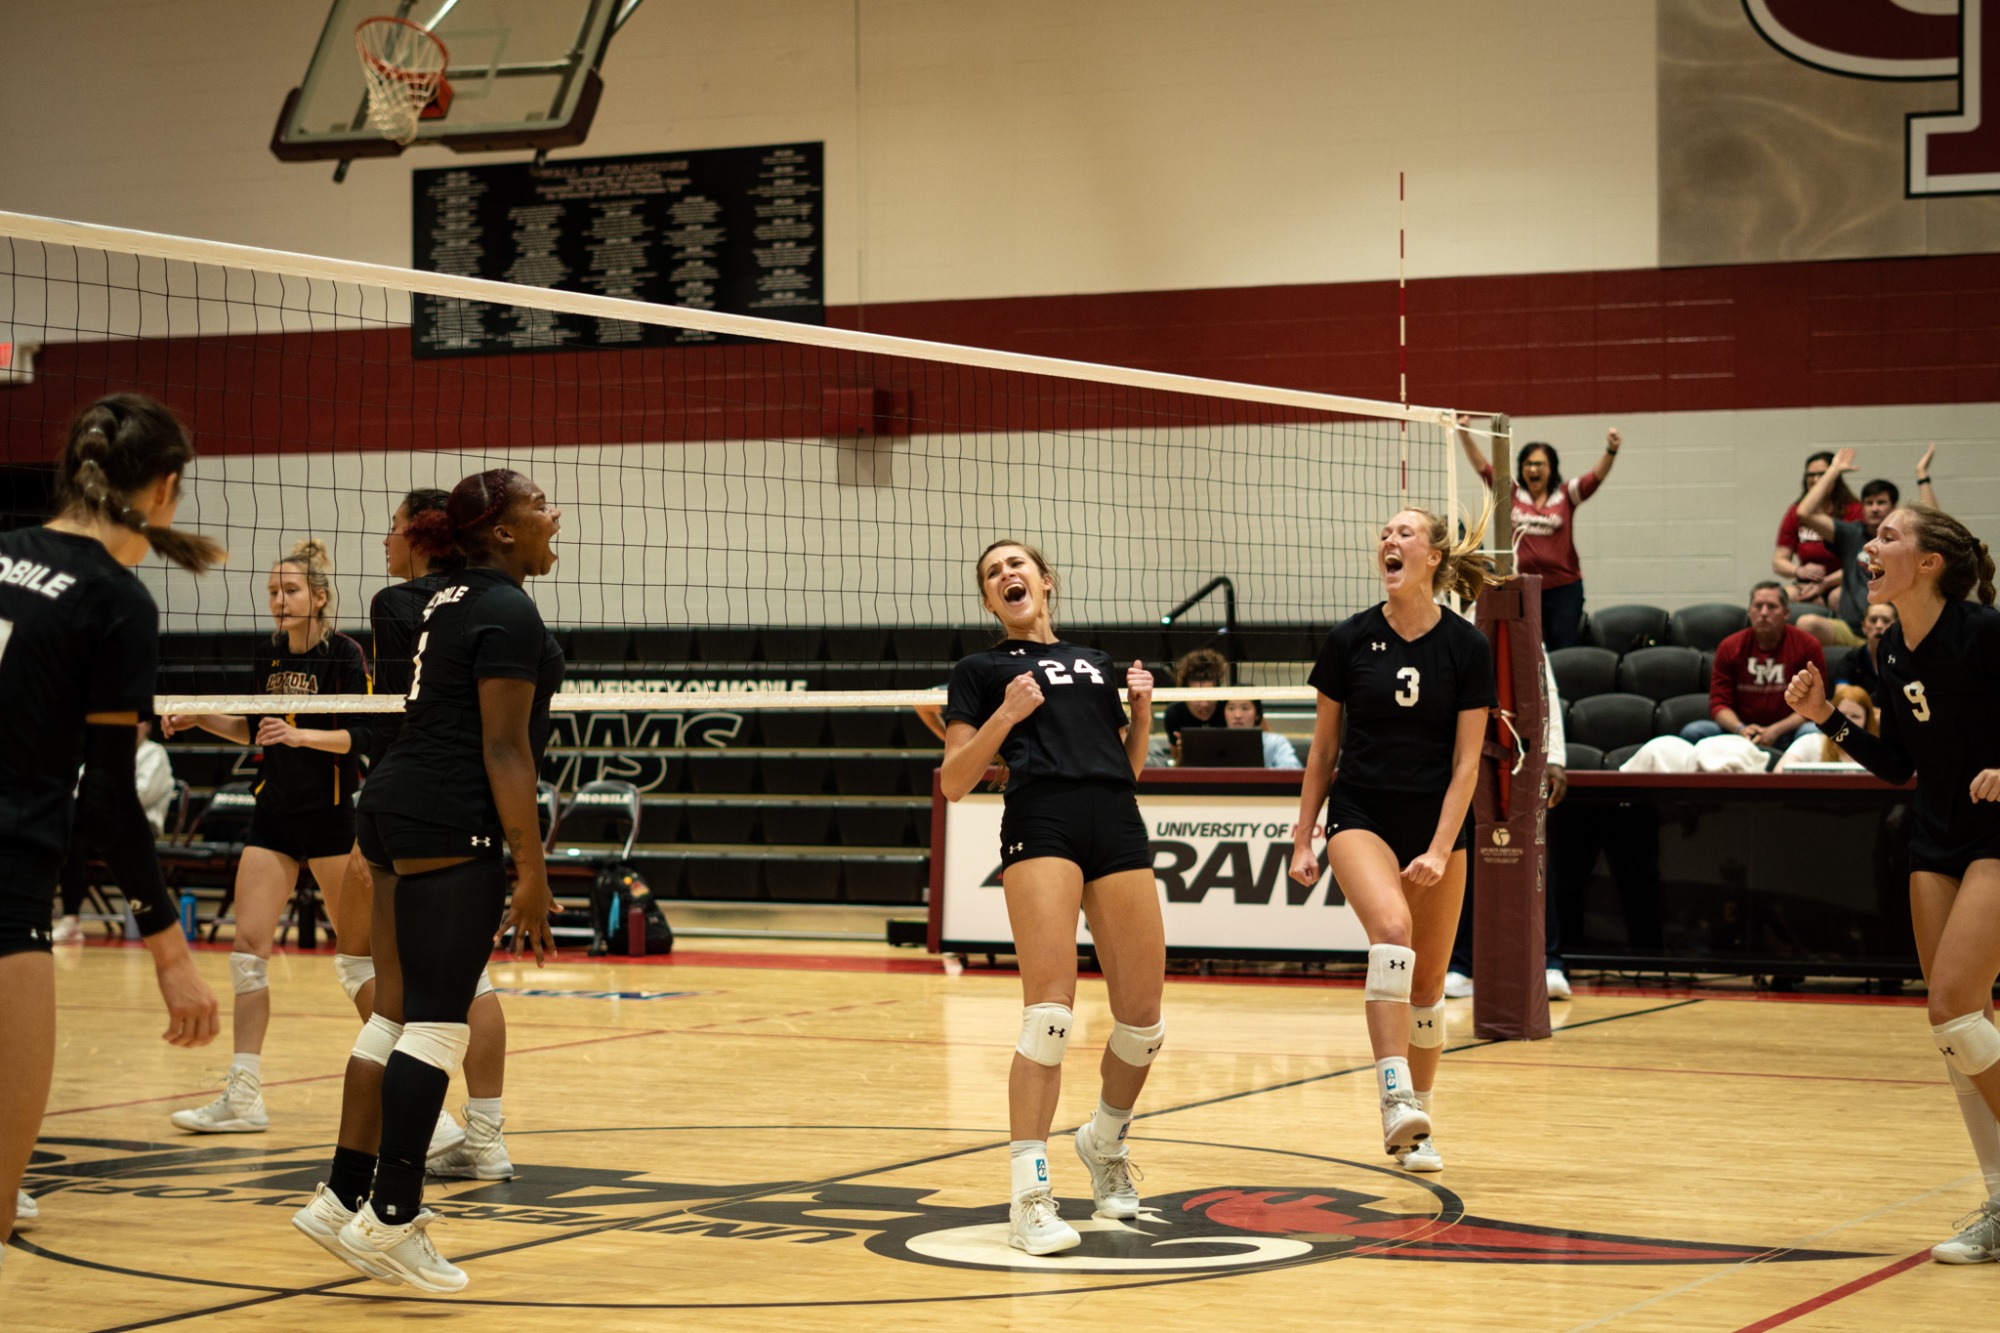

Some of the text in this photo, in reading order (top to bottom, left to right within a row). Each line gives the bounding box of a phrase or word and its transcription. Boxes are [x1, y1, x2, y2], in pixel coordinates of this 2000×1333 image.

[266, 671, 318, 694] LOYOLA
[1037, 659, 1105, 685] 24
[1747, 657, 1785, 685] UM
[1395, 666, 1420, 707] 3
[1903, 680, 1931, 722] 9
[576, 793, 631, 805] MOBILE
[1156, 822, 1261, 838] UNIVERSITY
[1263, 823, 1289, 838] OF
[1148, 840, 1347, 906] RAM
